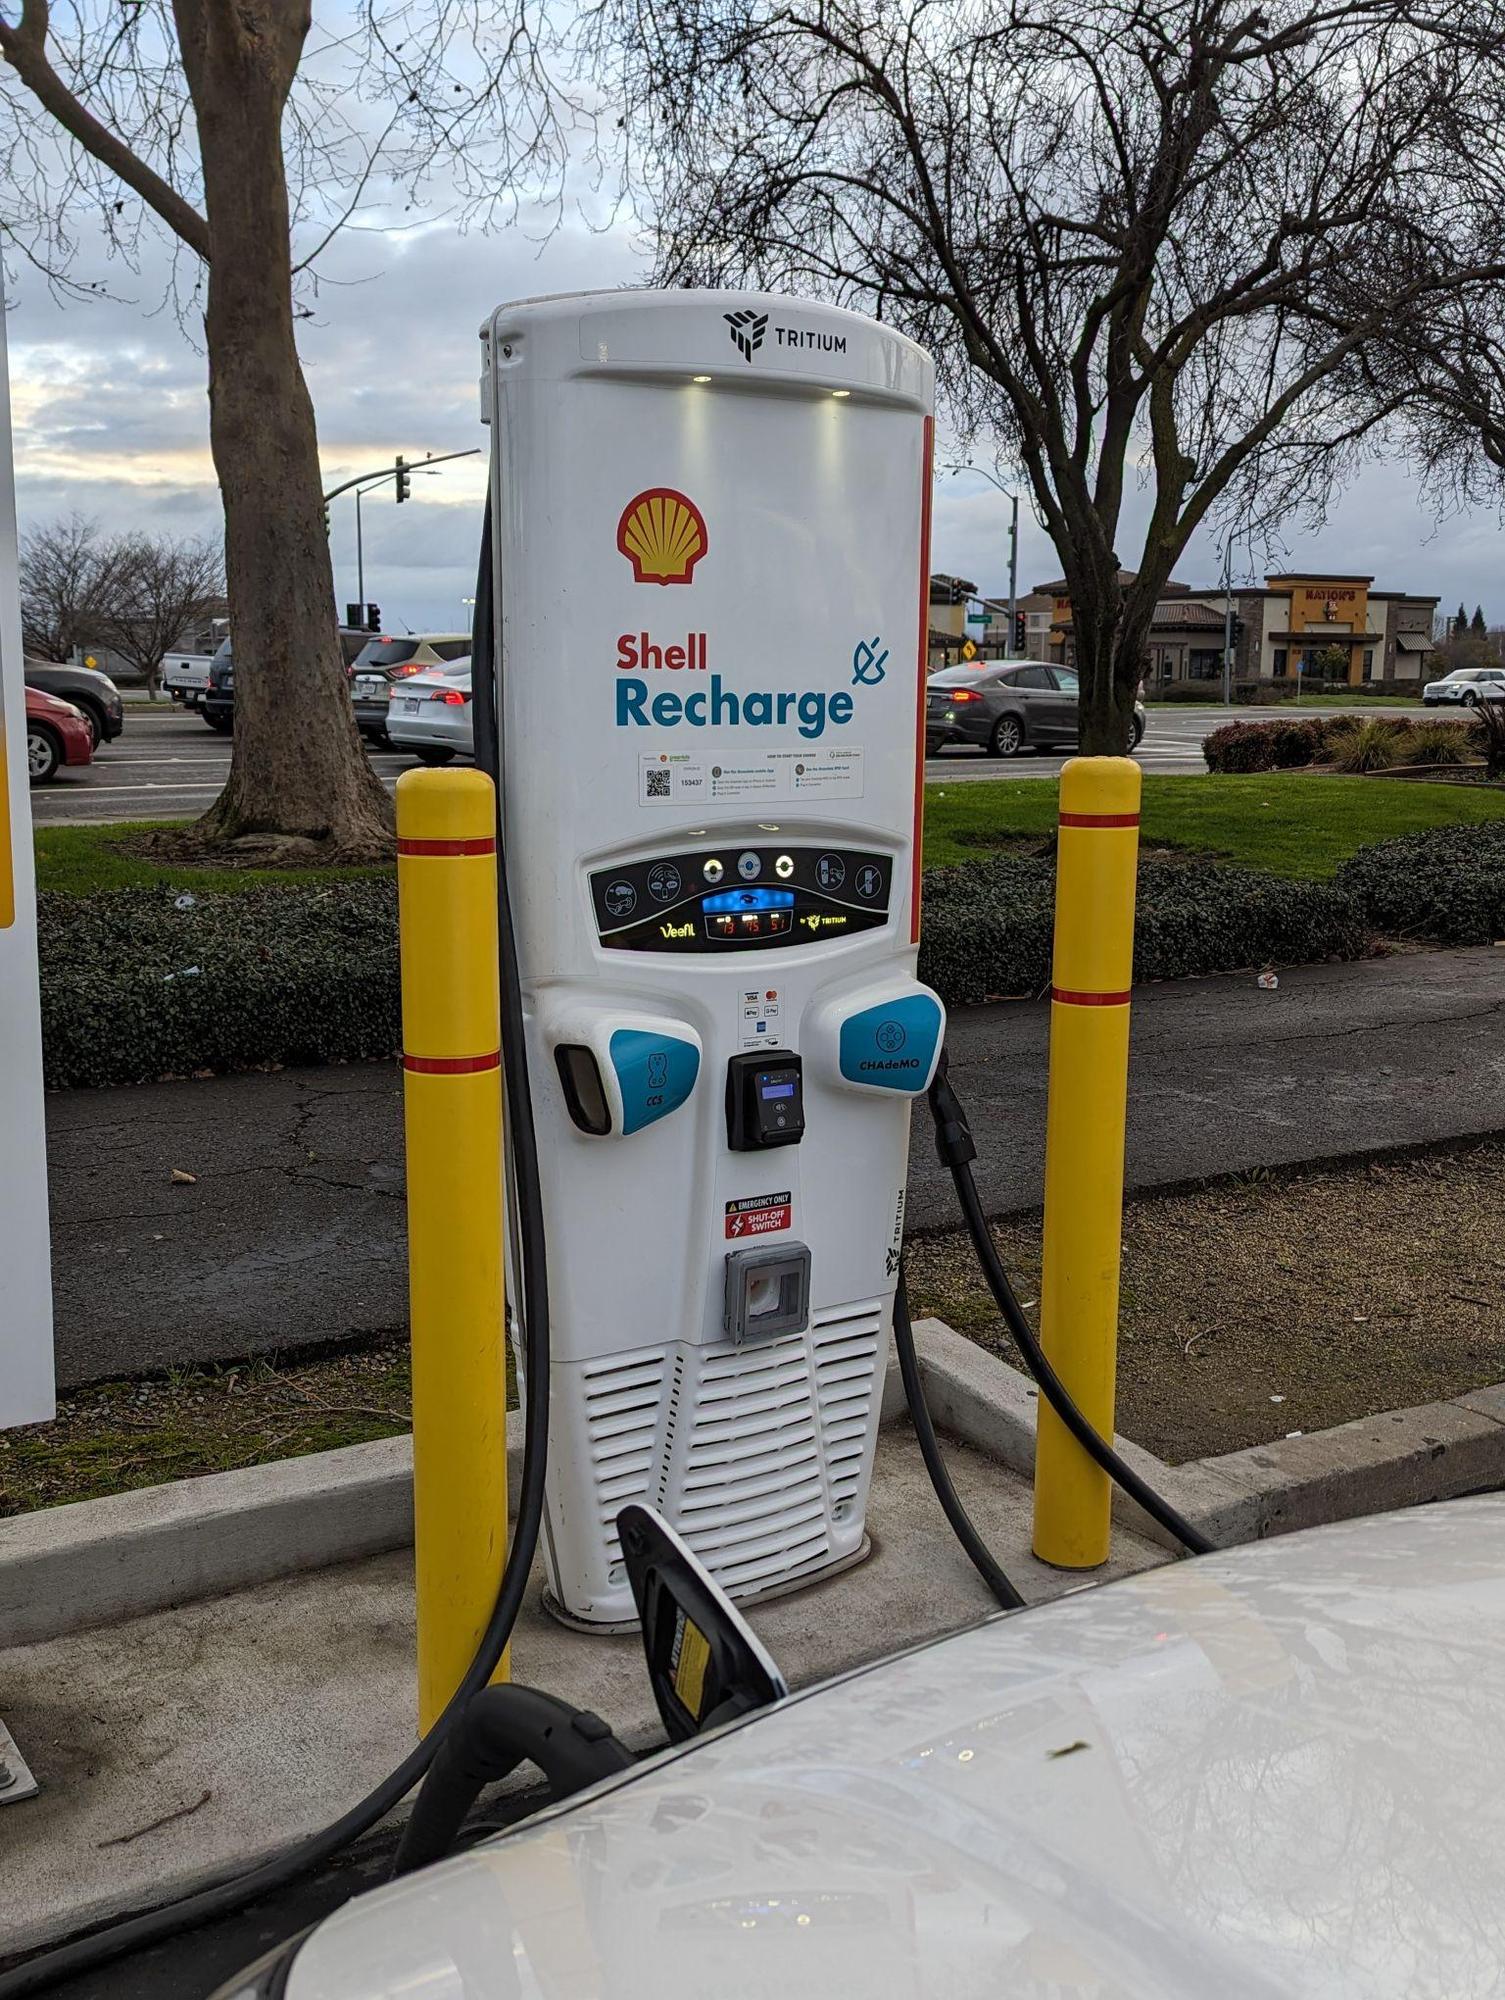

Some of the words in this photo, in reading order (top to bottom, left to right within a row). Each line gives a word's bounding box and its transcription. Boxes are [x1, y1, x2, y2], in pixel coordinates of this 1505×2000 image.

[775, 327, 847, 354] TRITIUM
[616, 631, 707, 670] Shell
[616, 674, 854, 739] Recharge
[681, 779, 703, 787] 153437
[821, 916, 847, 925] TRITIUM
[659, 922, 696, 938] Veefil
[860, 1058, 920, 1071] CHAdeMO
[646, 1095, 663, 1106] CCS
[738, 1197, 773, 1210] EMERGENCY
[773, 1193, 790, 1204] ONLY
[748, 1210, 785, 1224] SHUT-OFF
[893, 1189, 905, 1244] TRITIUM
[751, 1219, 782, 1232] SWITCH
